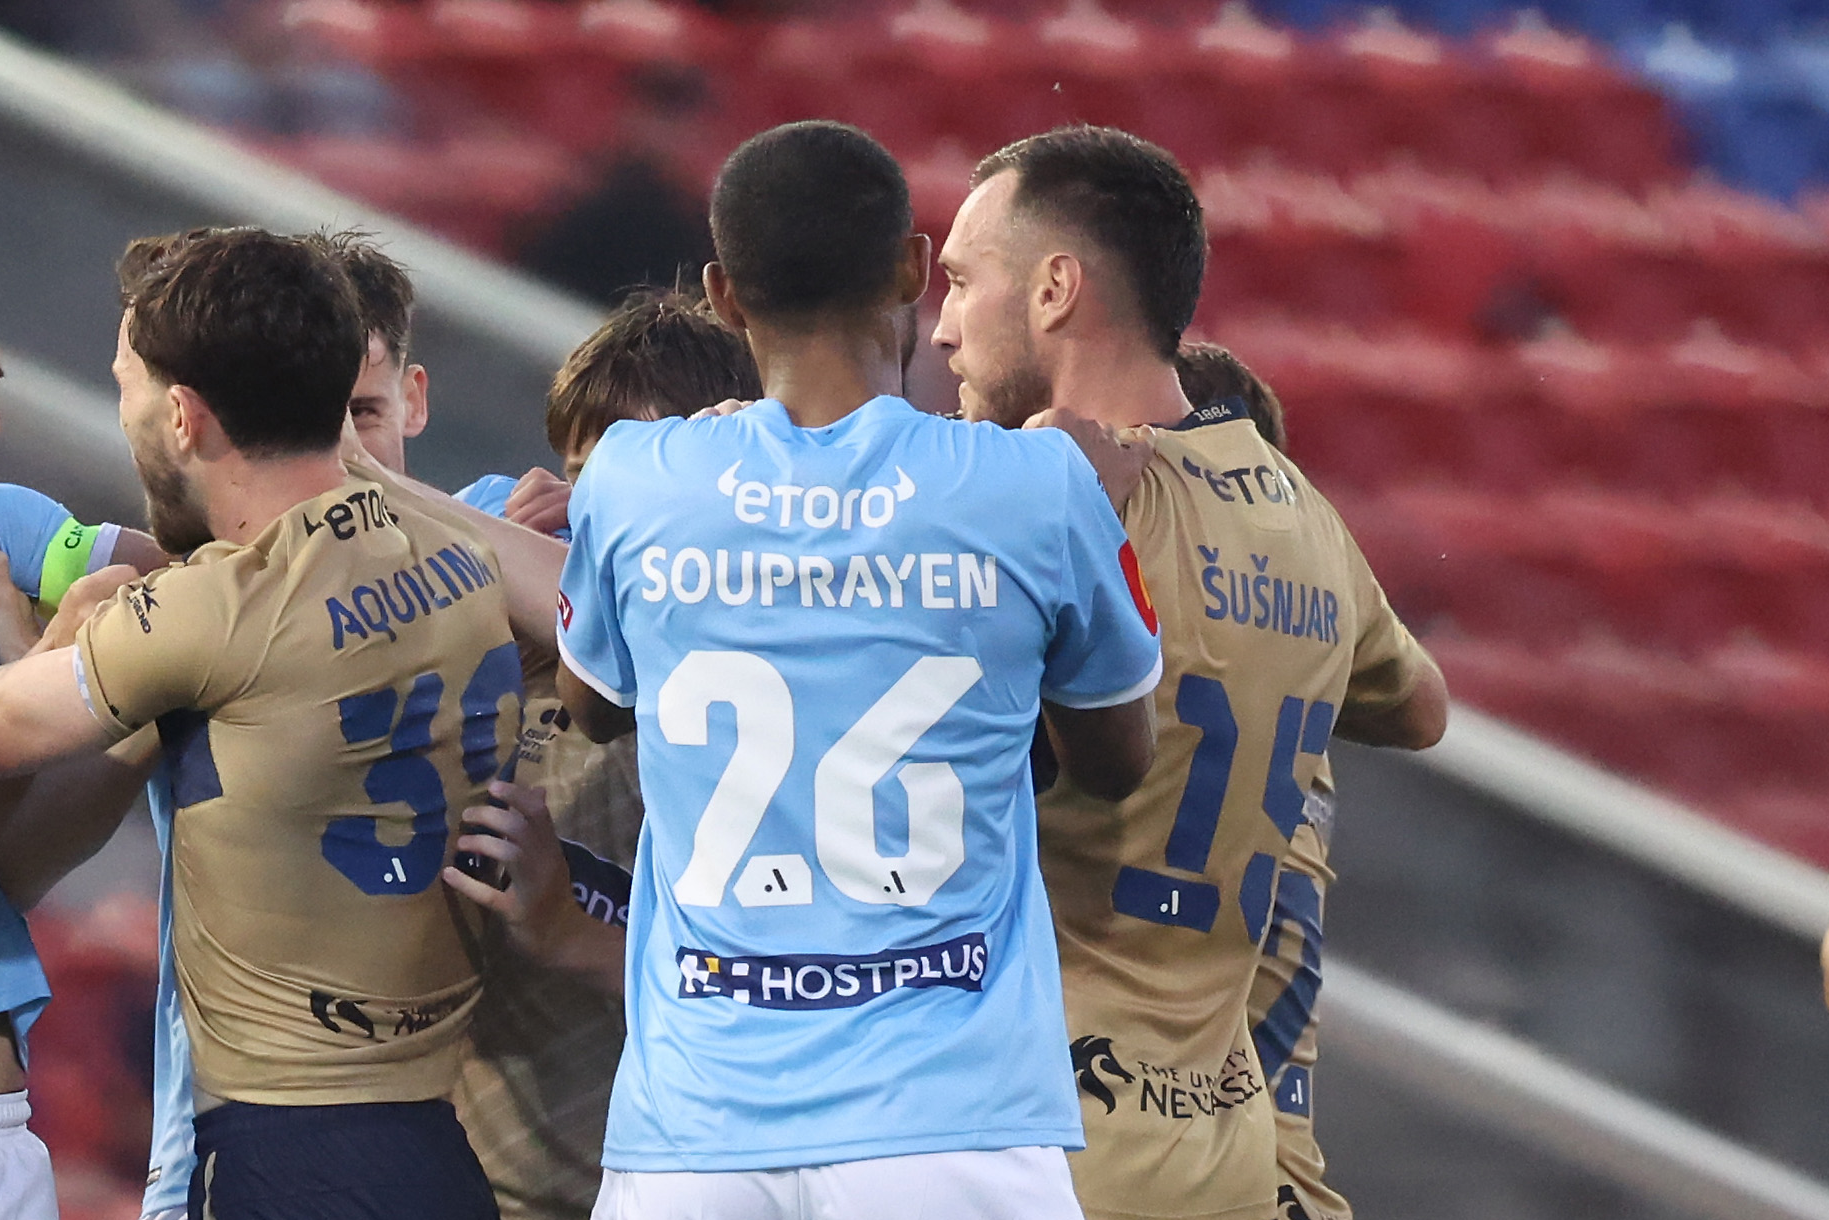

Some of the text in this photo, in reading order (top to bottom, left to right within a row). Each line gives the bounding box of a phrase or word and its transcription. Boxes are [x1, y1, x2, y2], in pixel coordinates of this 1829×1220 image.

[641, 546, 998, 609] SOUPRAYEN
[1197, 545, 1339, 646] ŠUŠNJAR
[657, 650, 984, 908] 26
[762, 944, 985, 1000] HOSTPLUS
